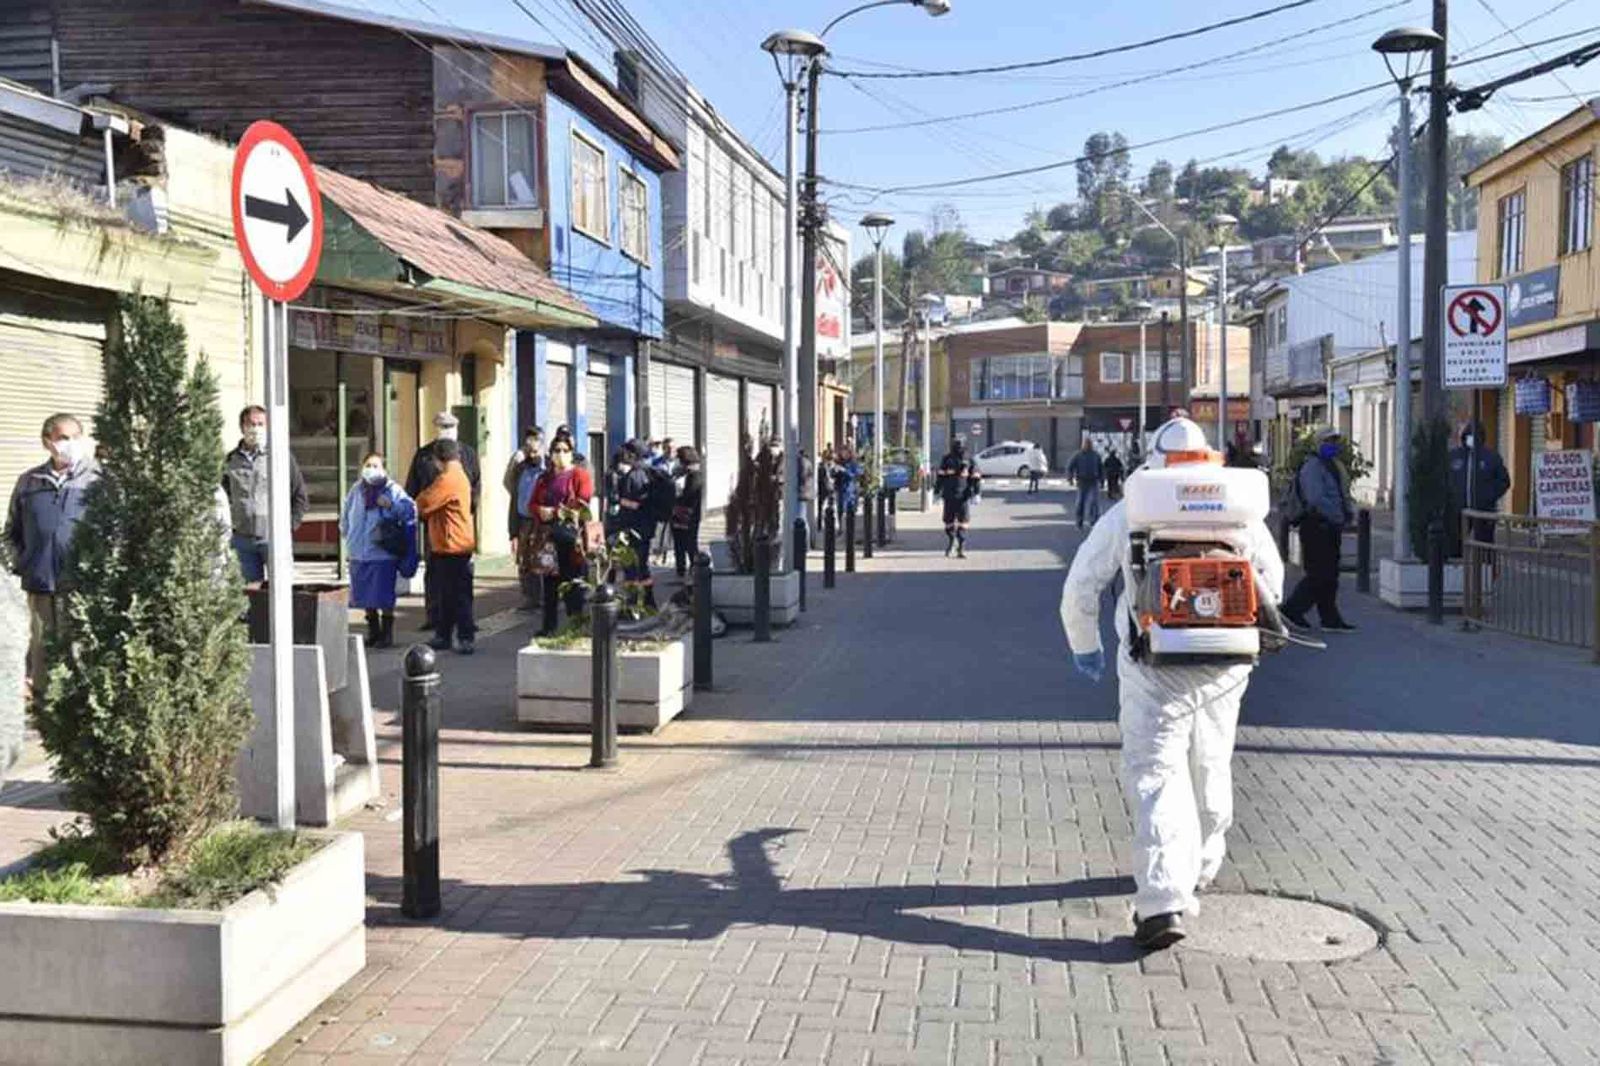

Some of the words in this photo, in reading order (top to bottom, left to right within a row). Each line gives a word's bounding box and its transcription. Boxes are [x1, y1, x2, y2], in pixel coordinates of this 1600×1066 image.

[1544, 453, 1582, 465] BOLSOS
[1539, 467, 1588, 479] MOCHILAS
[1539, 481, 1591, 493] CARTERAS
